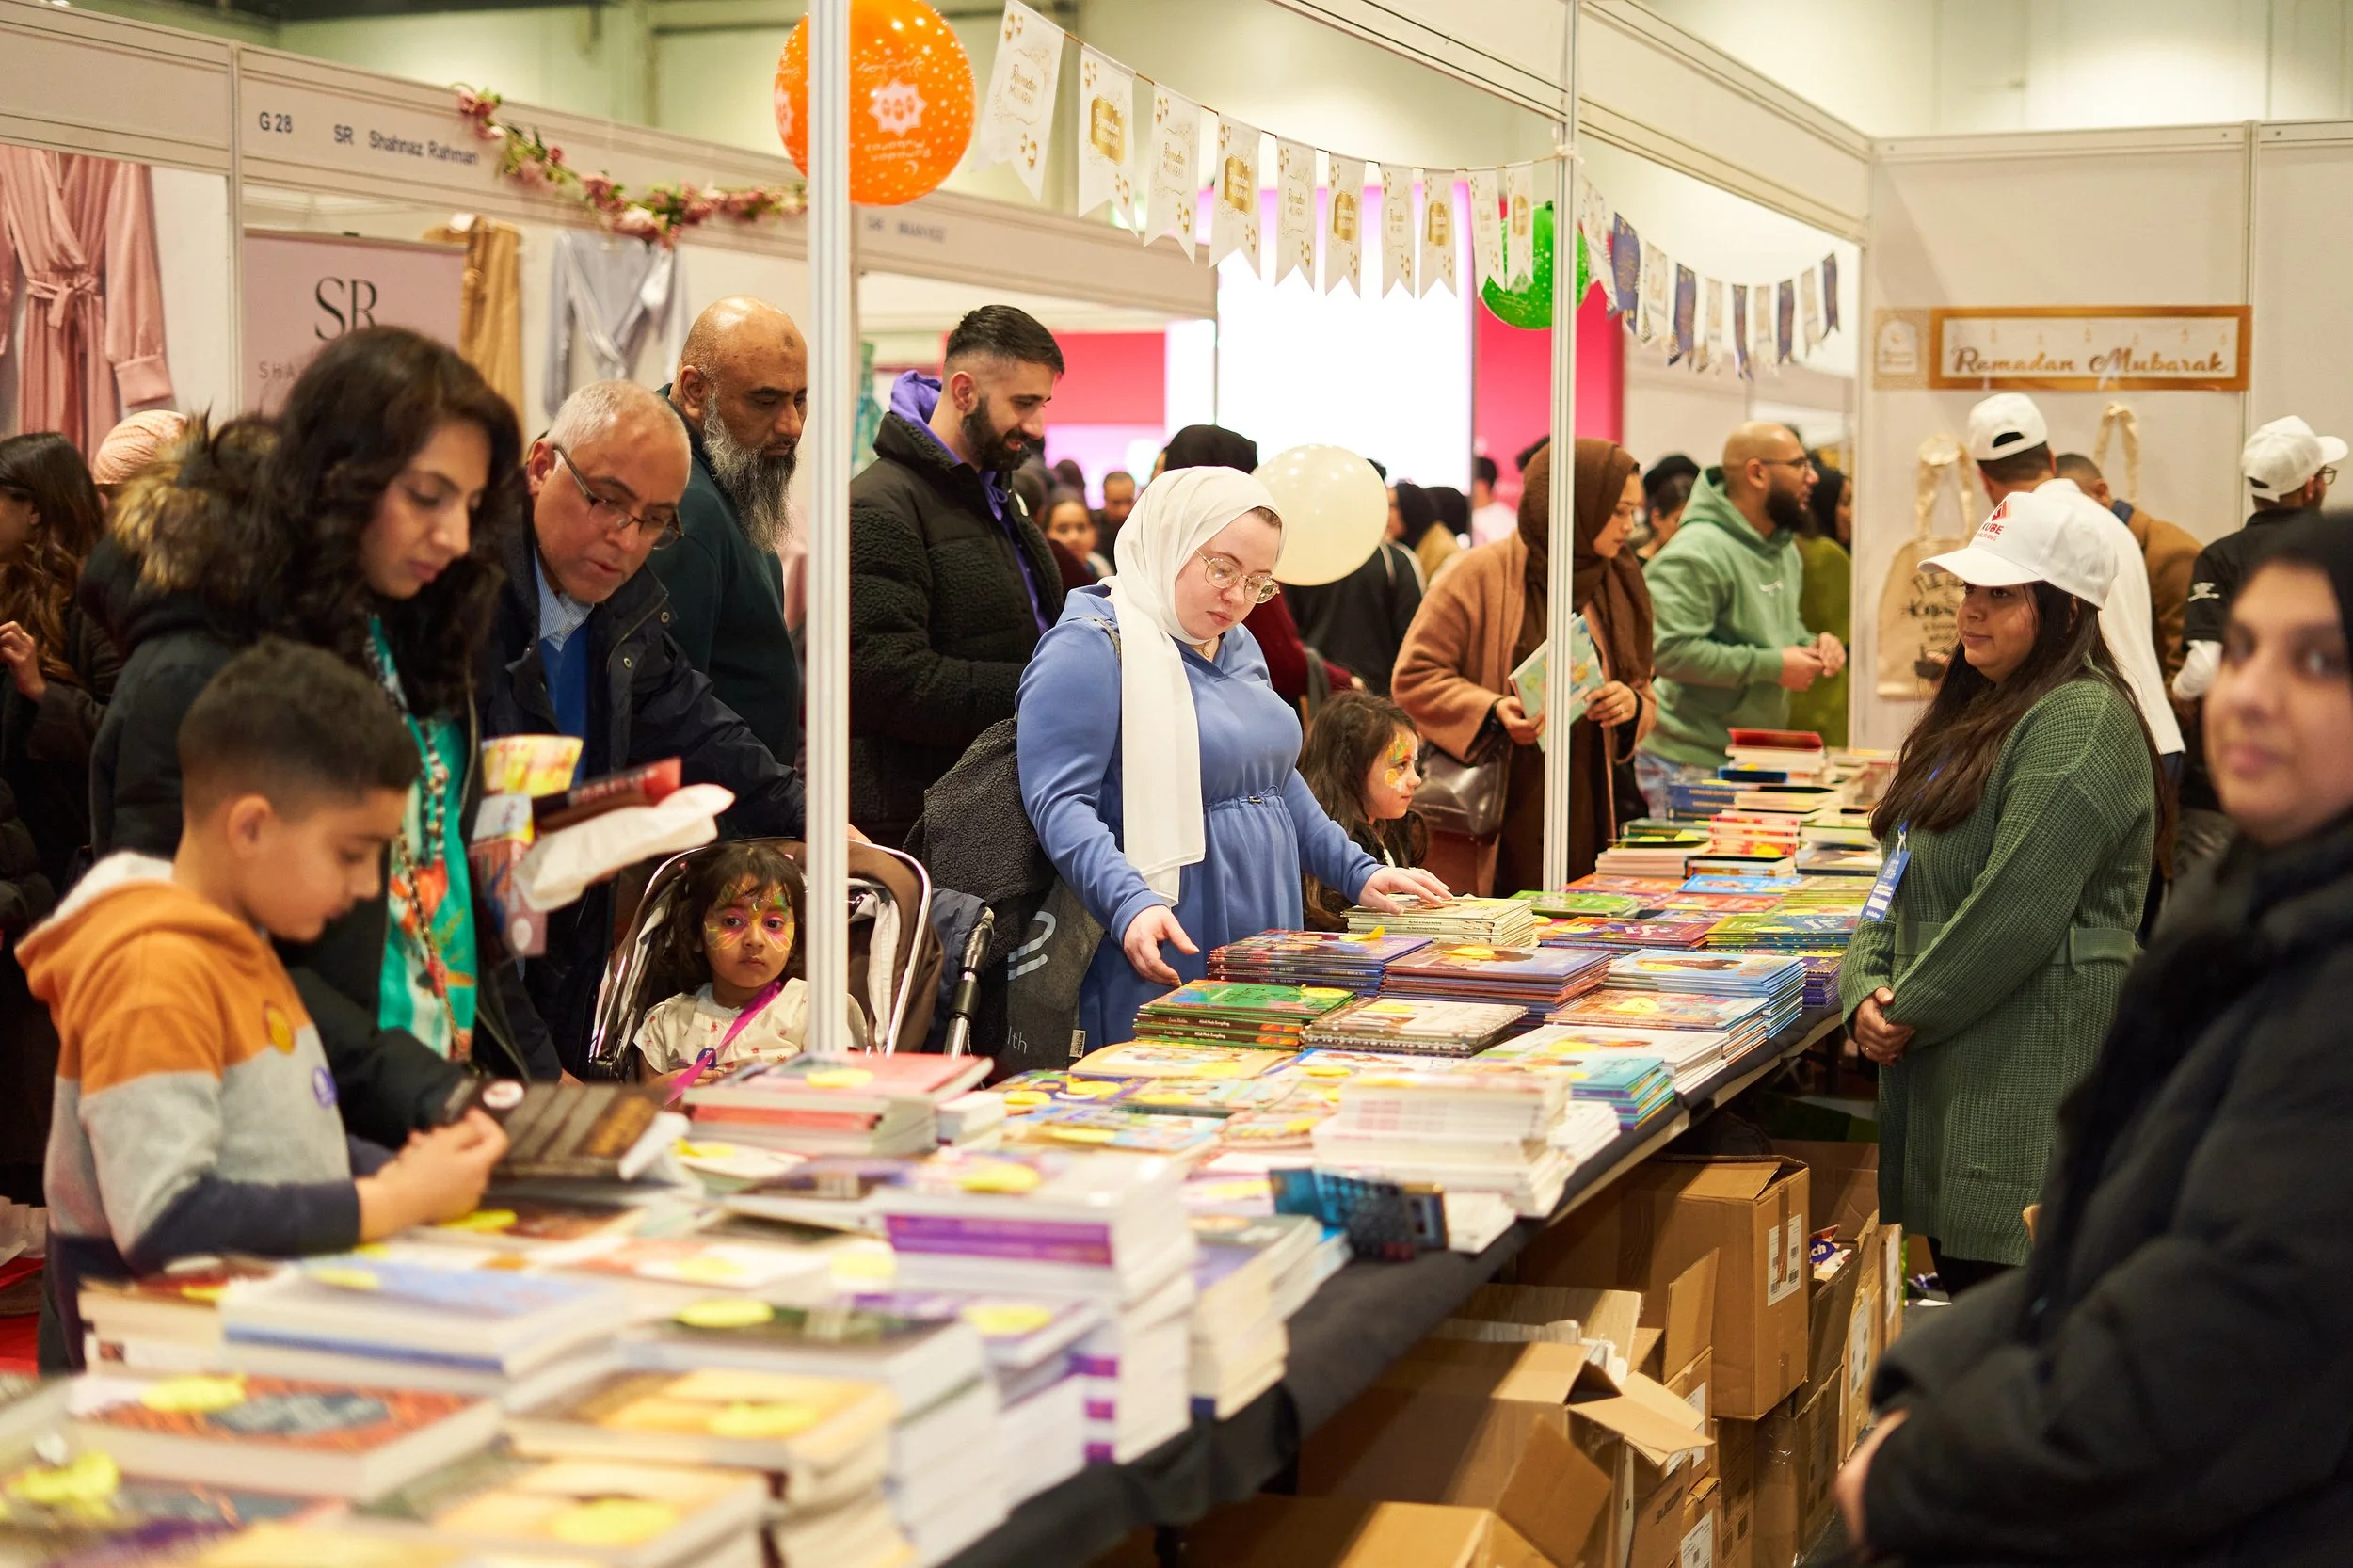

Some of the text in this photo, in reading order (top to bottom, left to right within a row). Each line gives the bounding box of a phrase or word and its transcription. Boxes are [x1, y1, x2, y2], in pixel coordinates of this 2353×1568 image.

[259, 111, 479, 166] G 28 SR Shahnaz Rahman
[314, 276, 377, 341] SR
[1951, 344, 2227, 374] Ramadan Mubarak
[1810, 1243, 1827, 1257] ch
